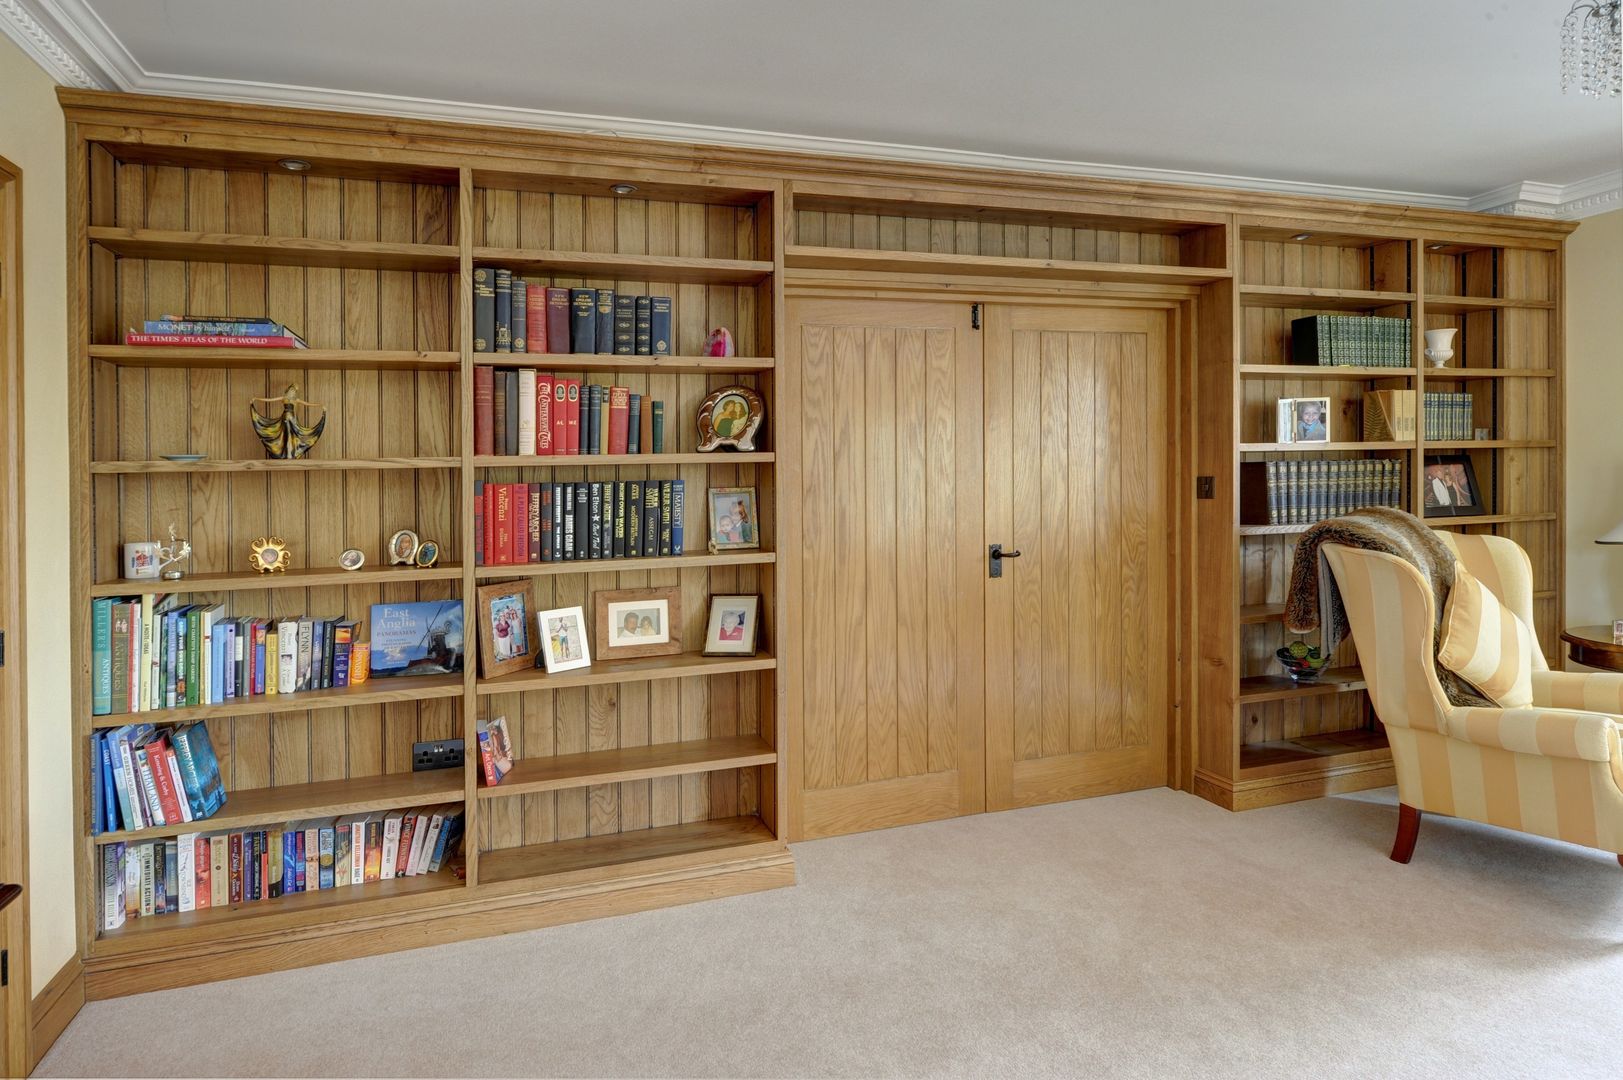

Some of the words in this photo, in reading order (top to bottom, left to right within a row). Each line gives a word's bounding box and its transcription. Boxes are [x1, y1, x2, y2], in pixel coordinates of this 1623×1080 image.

[157, 322, 193, 331] MONET
[194, 325, 203, 333] by
[151, 335, 180, 343] TIMES
[182, 336, 206, 344] ATLAS
[220, 337, 237, 345] THE
[238, 337, 268, 346] WORLD
[538, 382, 551, 395] THE
[538, 395, 551, 432] CANTERBURY
[538, 431, 551, 449] TALES
[498, 487, 507, 521] Vincenzi
[531, 493, 540, 517] JEFFREY
[592, 496, 600, 514] Elton
[645, 488, 653, 508] SMITH
[565, 514, 573, 534] JAMES
[565, 534, 573, 551] CAAN
[384, 608, 410, 618] East
[96, 602, 106, 648] MILLER'S
[380, 618, 416, 629] Anglia
[301, 626, 310, 652] FLYNN
[113, 641, 123, 690] ANTIQUES
[102, 658, 111, 694] ANTIQUES
[178, 735, 192, 761] JEFFREY
[142, 768, 160, 811] THAILAND
[161, 782, 169, 796] Corby
